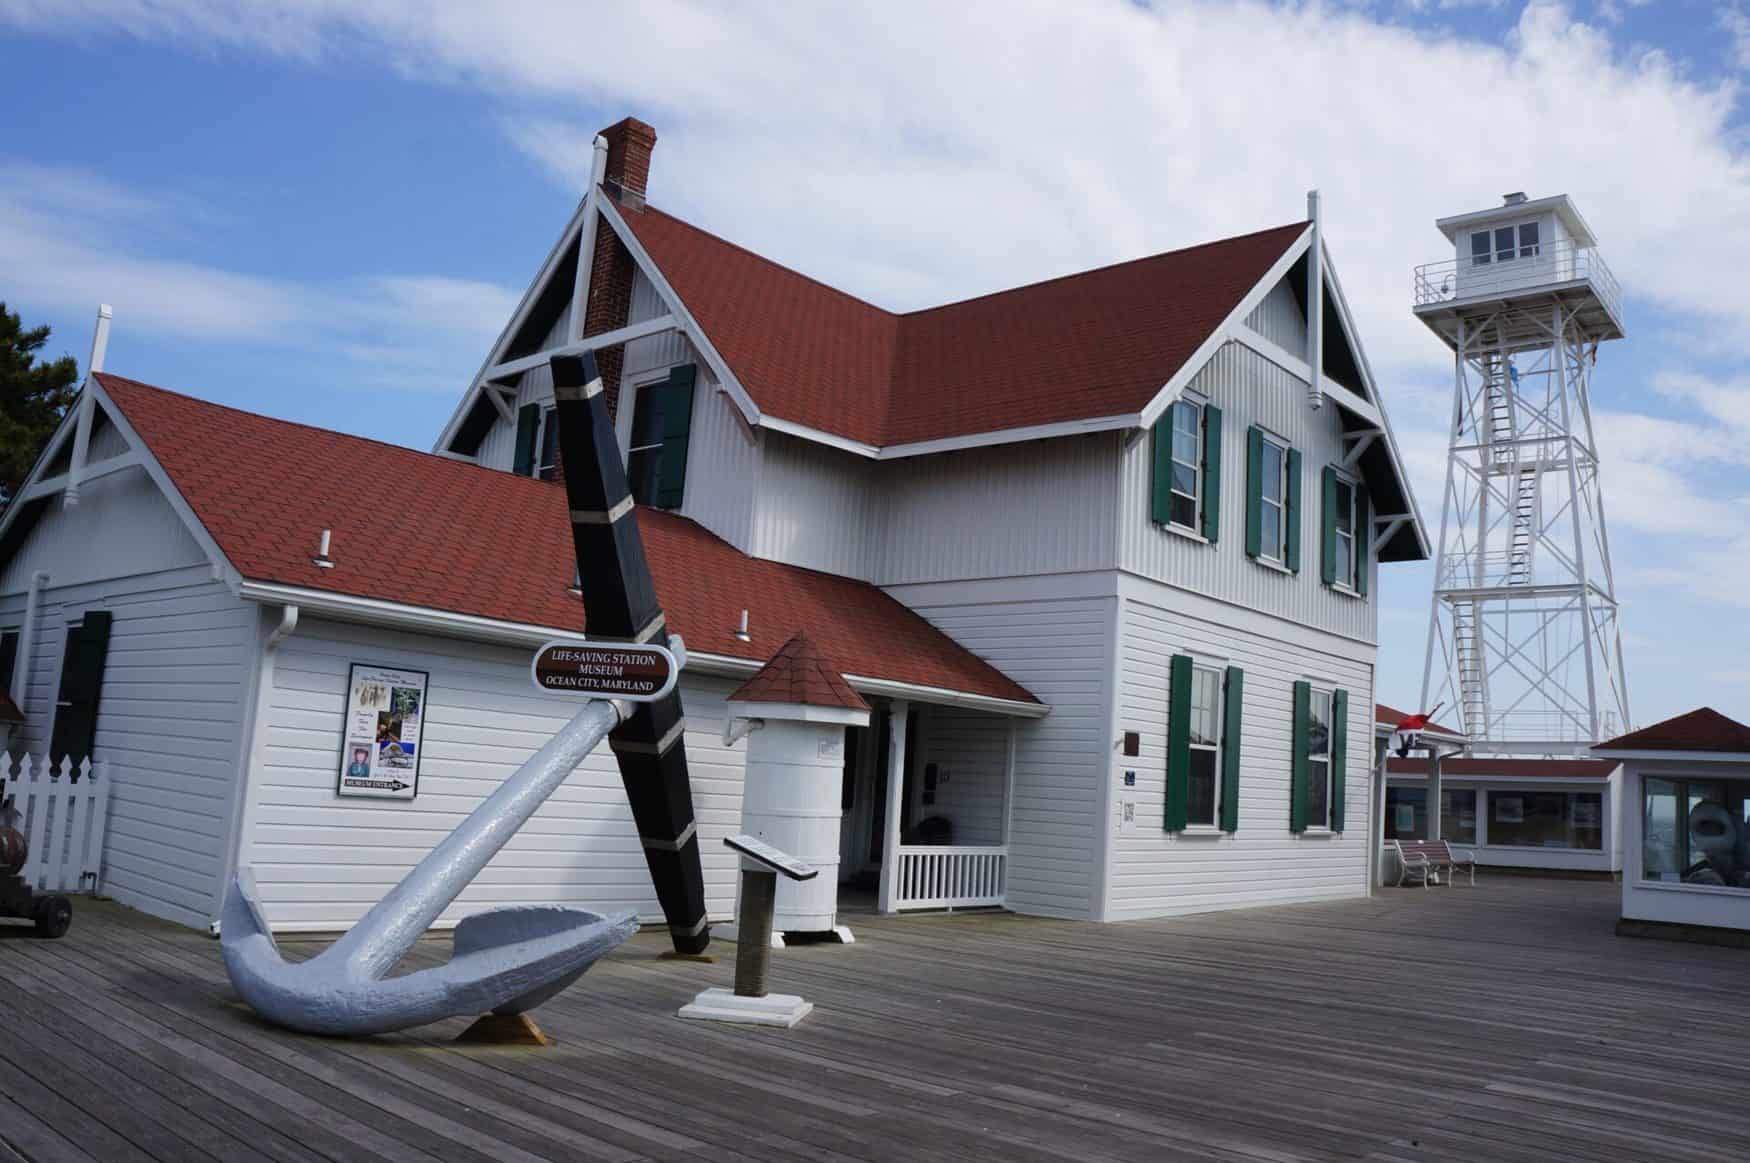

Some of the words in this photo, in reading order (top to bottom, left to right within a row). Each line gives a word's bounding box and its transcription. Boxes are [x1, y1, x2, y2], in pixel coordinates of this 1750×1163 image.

[552, 650, 611, 663] LIFE-SAVING
[612, 654, 656, 665] STATION
[579, 664, 623, 676] MUSEUM
[546, 675, 577, 686] OCEAN
[601, 679, 654, 691] MARYLAND
